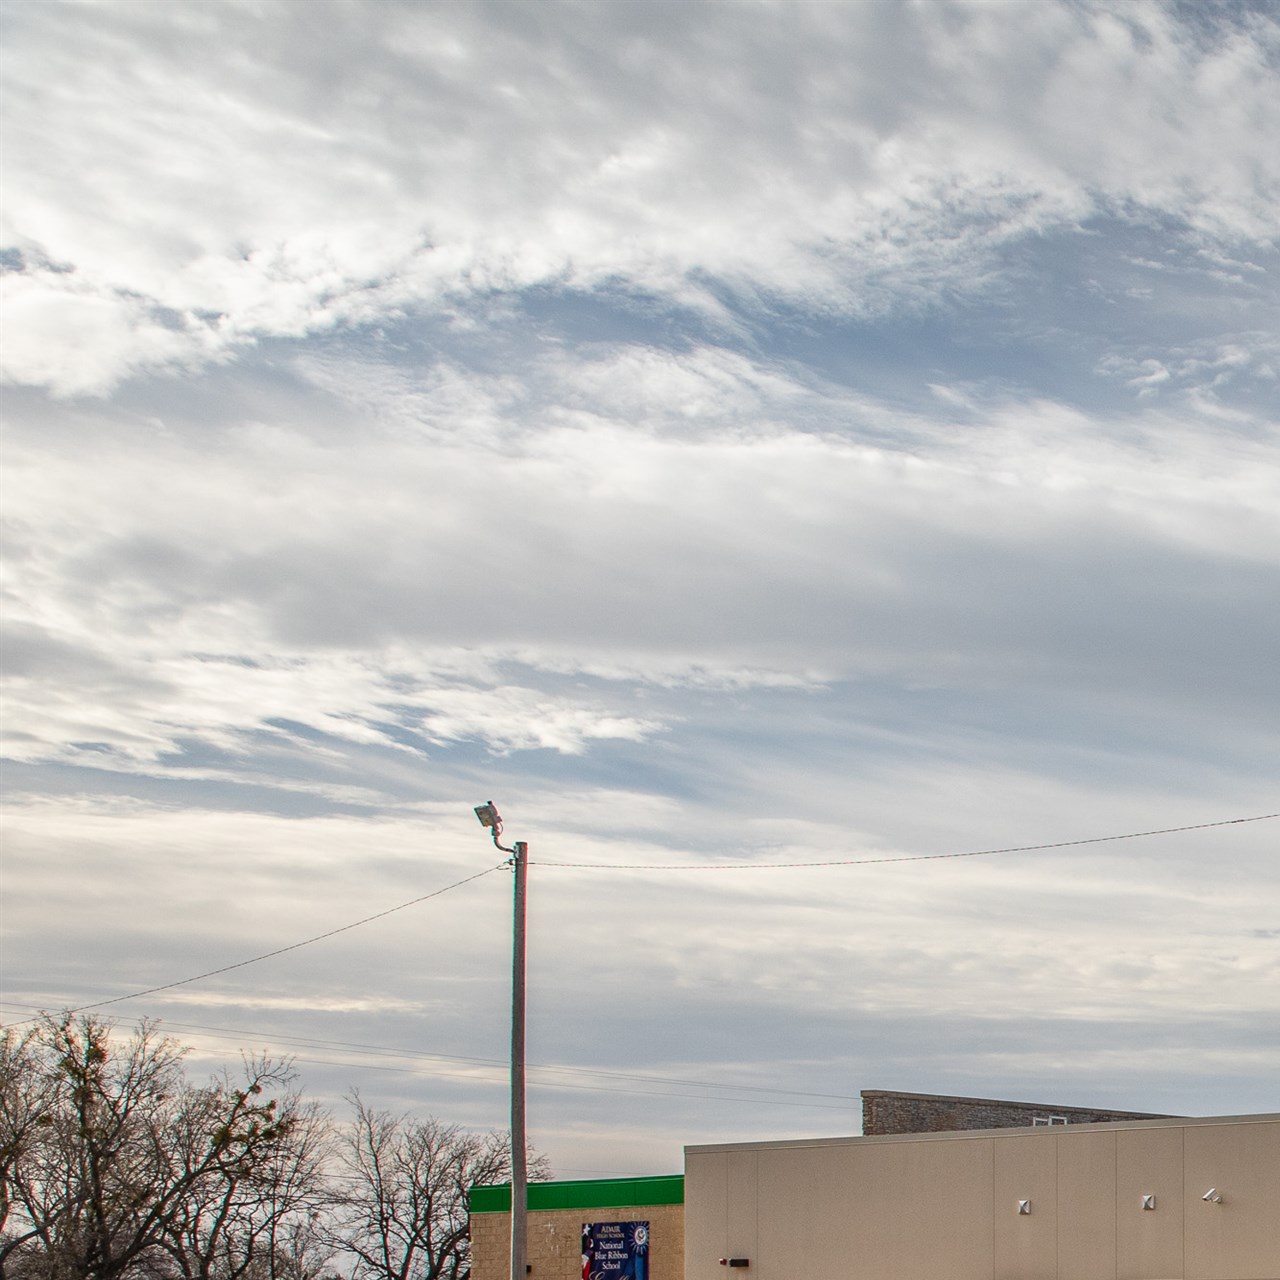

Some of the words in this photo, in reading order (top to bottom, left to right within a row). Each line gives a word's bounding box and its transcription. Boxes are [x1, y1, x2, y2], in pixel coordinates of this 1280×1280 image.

[601, 1225, 621, 1233] ADAIR
[600, 1240, 624, 1249] National
[595, 1251, 607, 1260] Blue
[608, 1251, 629, 1260] Ribbon
[602, 1261, 621, 1269] School
